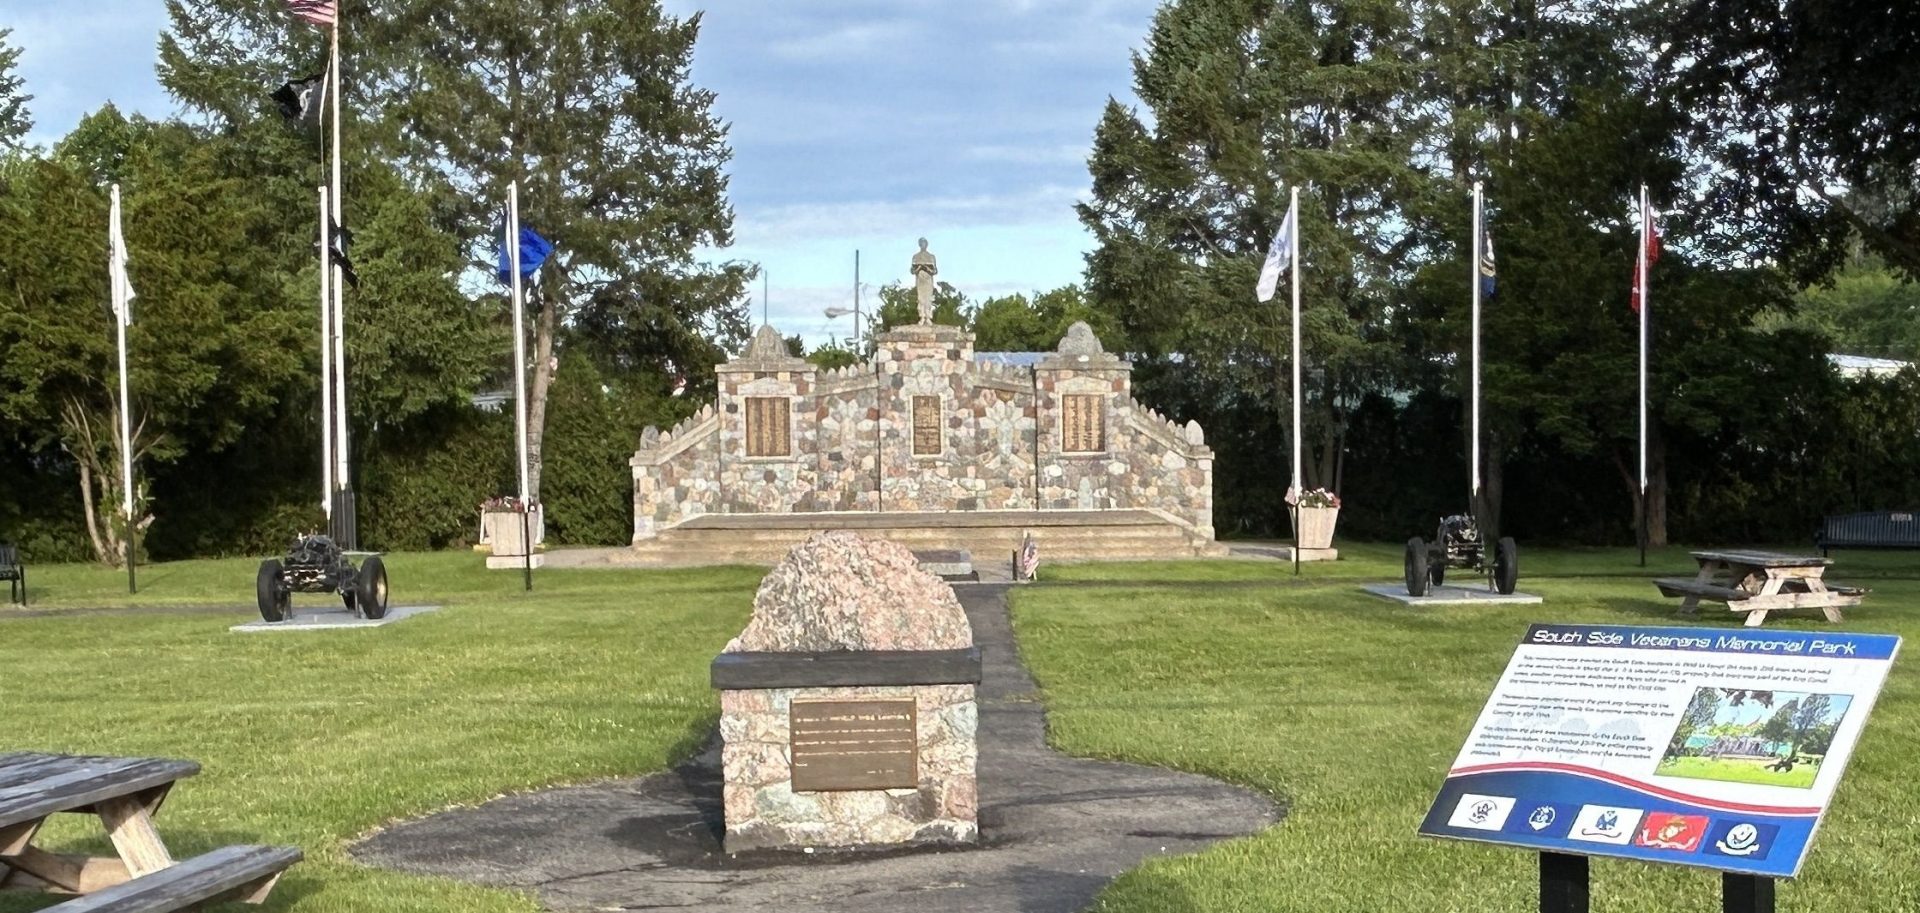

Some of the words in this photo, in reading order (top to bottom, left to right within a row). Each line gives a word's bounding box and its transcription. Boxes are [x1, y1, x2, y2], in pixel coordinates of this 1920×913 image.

[1533, 629, 1582, 643] South
[1586, 631, 1624, 645] Side
[1715, 636, 1805, 652] Memorial
[1808, 640, 1857, 655] Park
